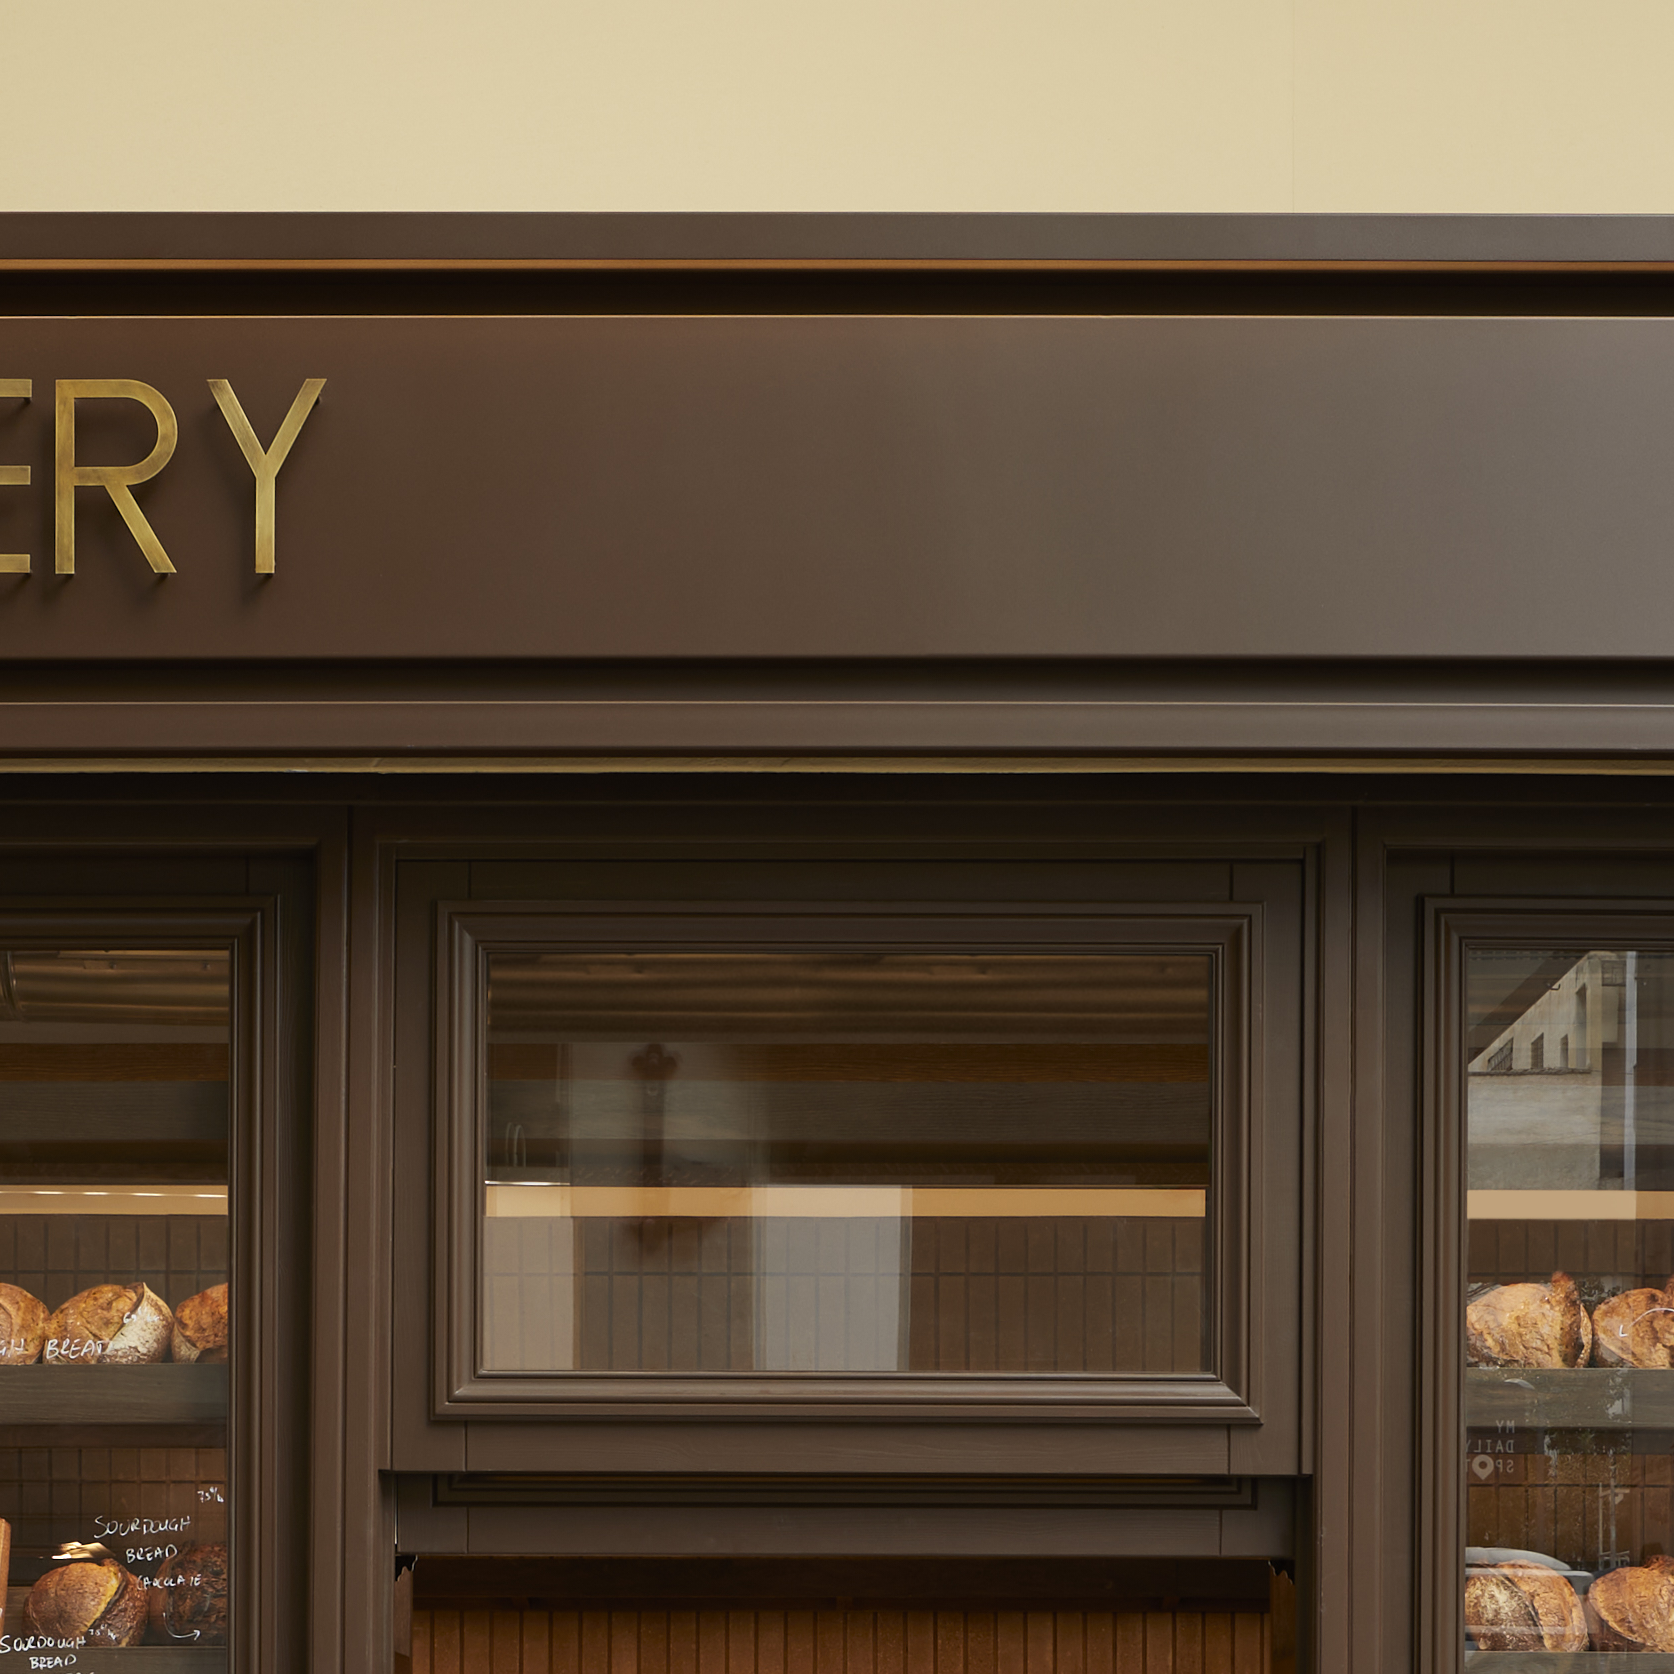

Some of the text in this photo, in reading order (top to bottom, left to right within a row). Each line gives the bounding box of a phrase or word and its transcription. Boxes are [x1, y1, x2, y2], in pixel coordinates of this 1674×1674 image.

[44, 1338, 116, 1360] BREAD
[93, 1514, 191, 1539] SOURDOUGH
[126, 1544, 179, 1565] BREAD
[0, 1634, 87, 1655] SOURDOUGH
[29, 1653, 77, 1670] BREAD
